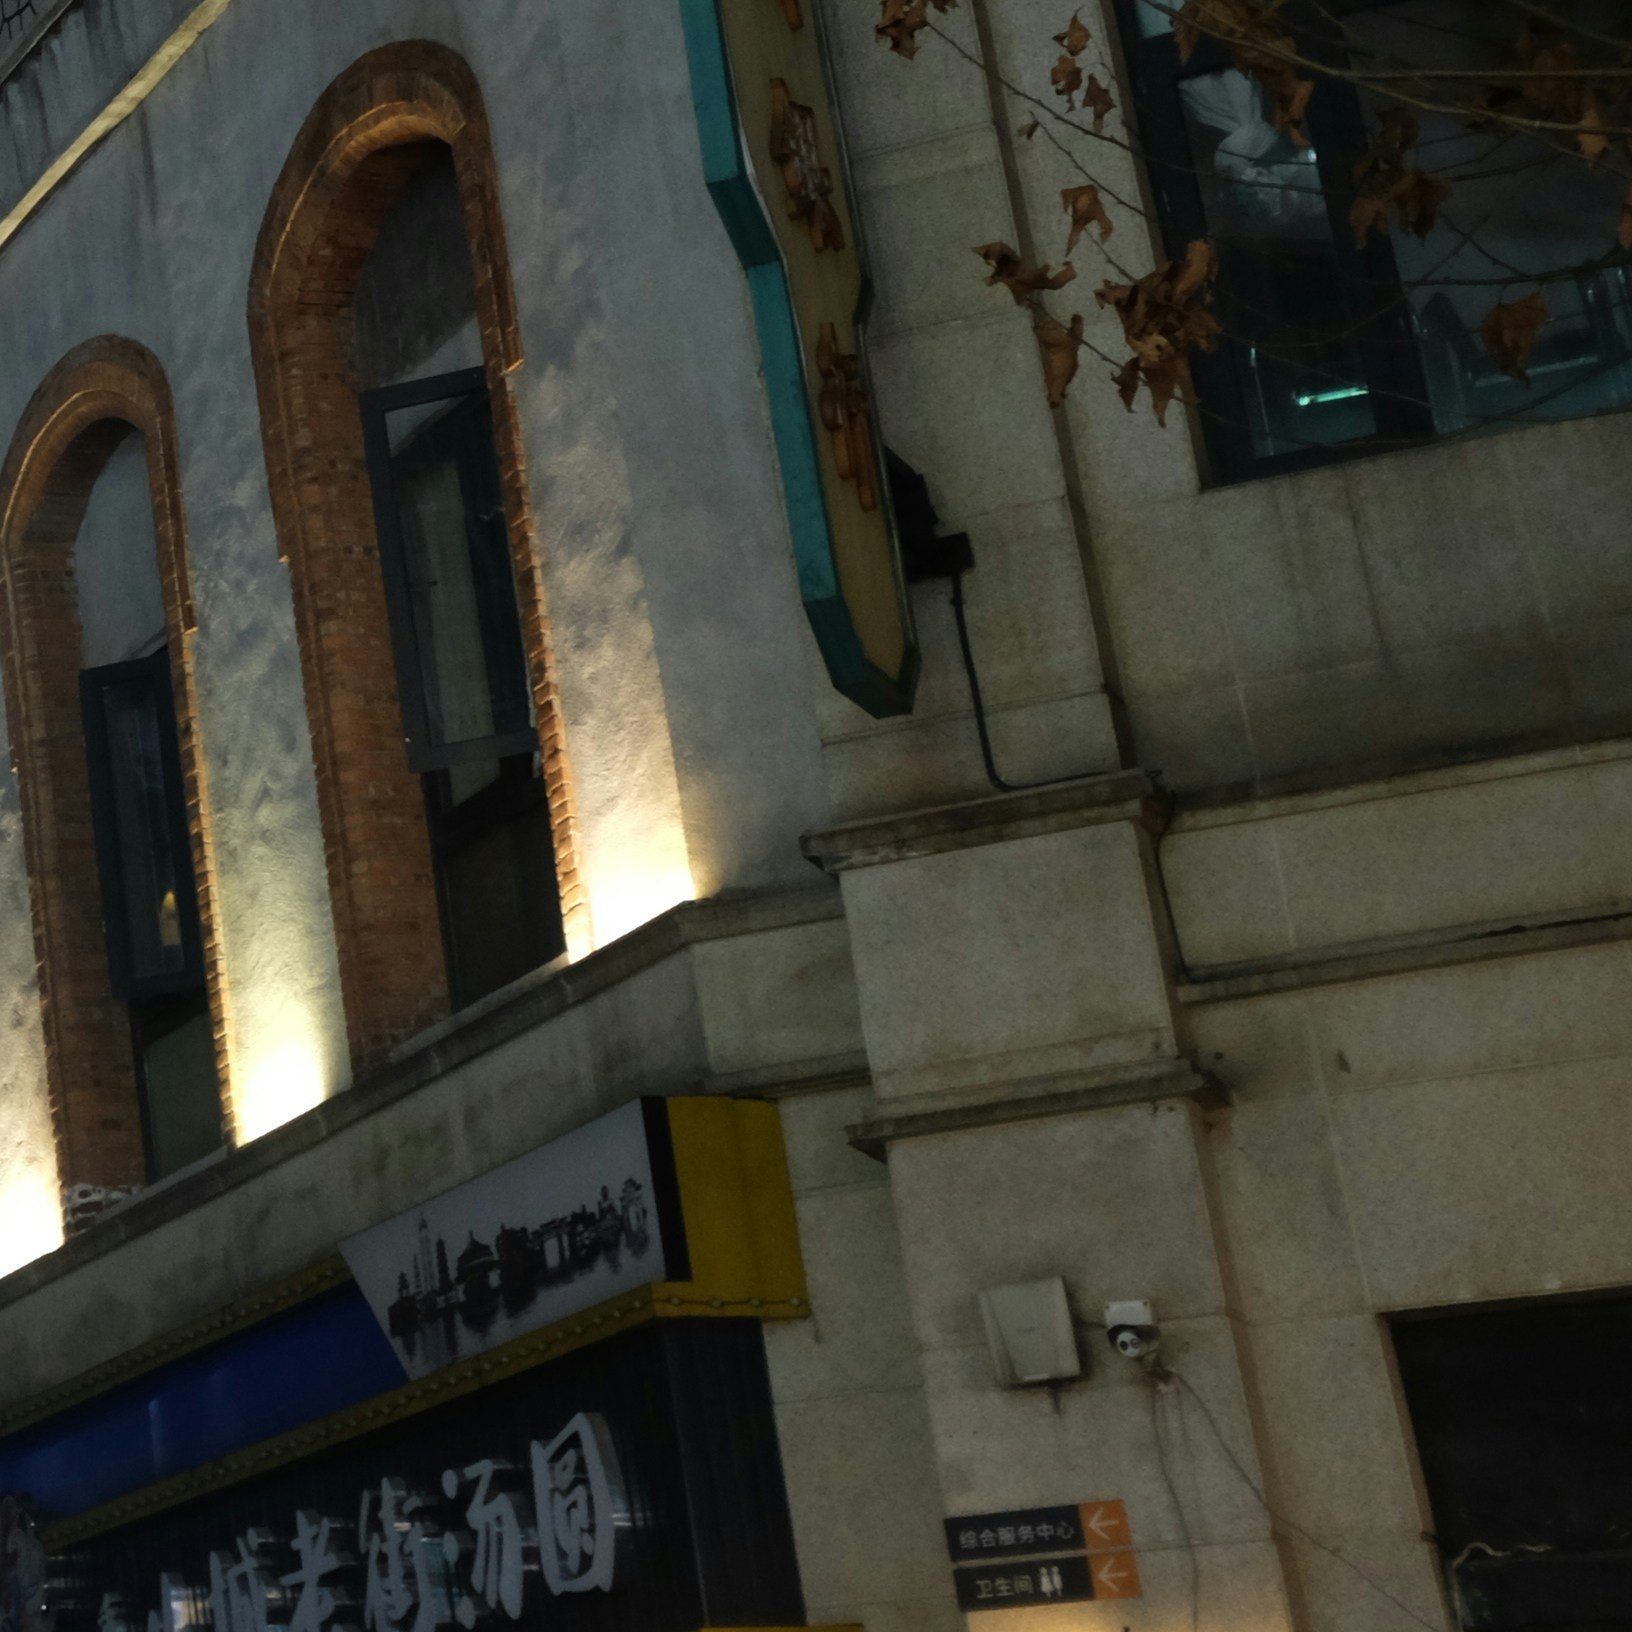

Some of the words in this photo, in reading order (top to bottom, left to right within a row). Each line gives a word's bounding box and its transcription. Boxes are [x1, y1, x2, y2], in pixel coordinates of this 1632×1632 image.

[959, 1521, 1075, 1550] 综合服务中心
[975, 1574, 1034, 1599] 卫生间
